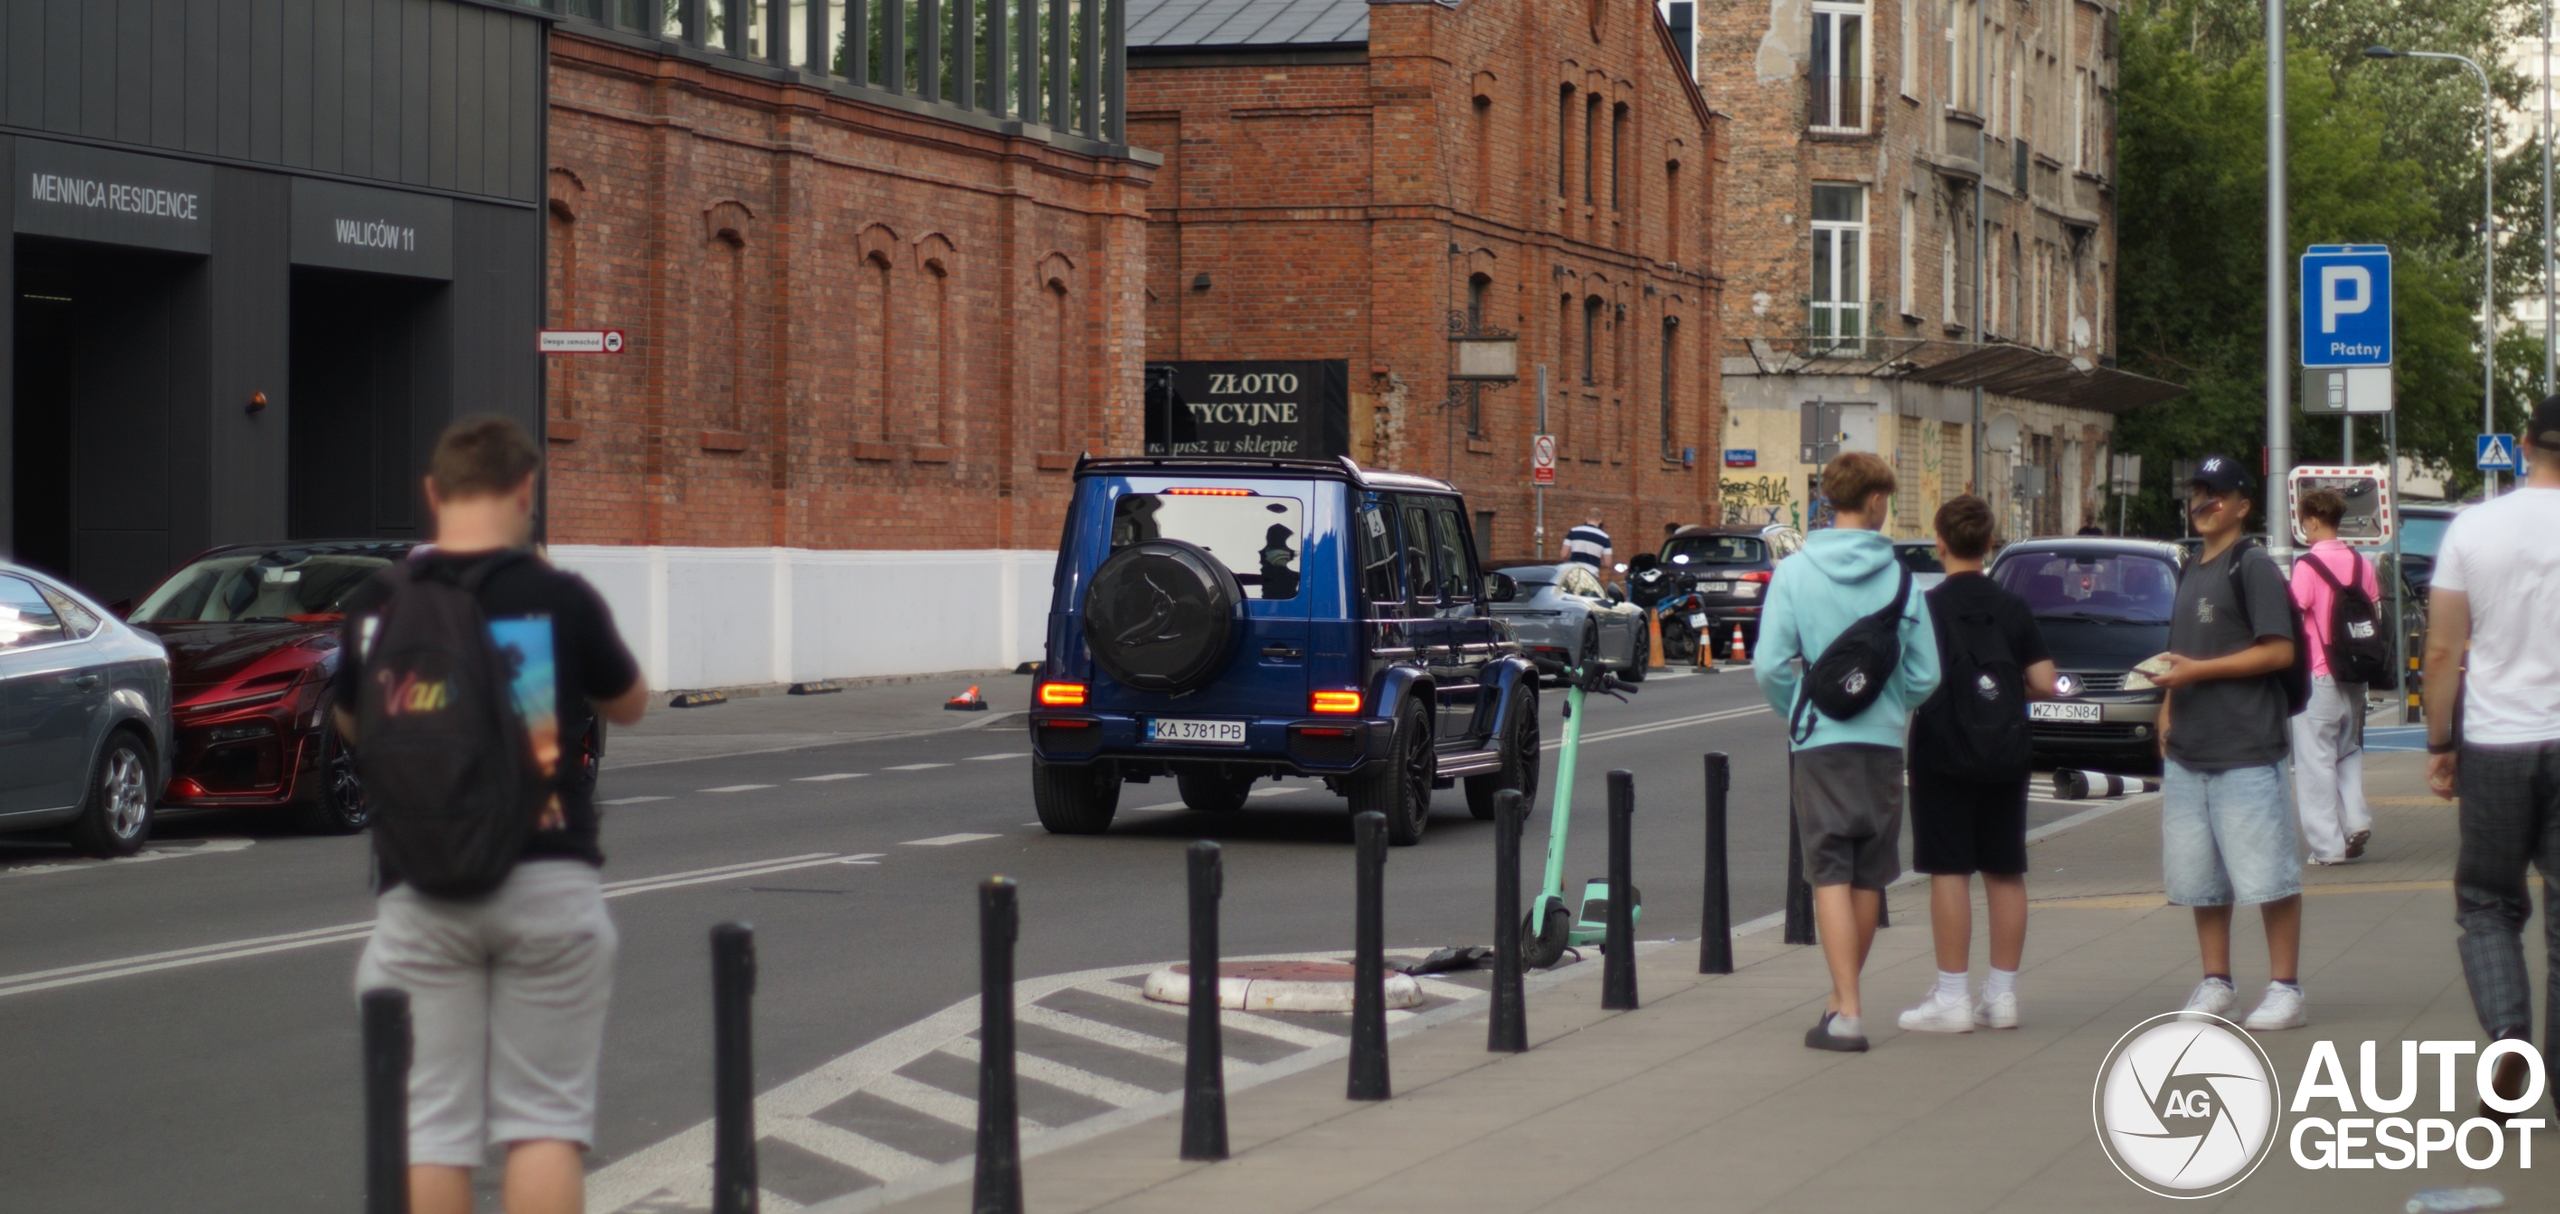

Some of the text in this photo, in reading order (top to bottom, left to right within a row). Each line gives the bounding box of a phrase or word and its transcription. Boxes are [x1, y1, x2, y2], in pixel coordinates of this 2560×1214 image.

[32, 172, 198, 221] MENNICA RESIDENCE
[335, 218, 415, 252] WALICÓW 11
[2321, 265, 2371, 334] P
[543, 337, 565, 347] Uwaga
[2330, 341, 2382, 360] Płatny
[1208, 373, 1299, 394] ZŁOTO
[1213, 441, 1230, 454] w
[1234, 434, 1299, 457] sklepie
[376, 668, 457, 716] Van
[2033, 703, 2099, 719] WZY SN84
[1156, 721, 1242, 740] KA 3781 PB
